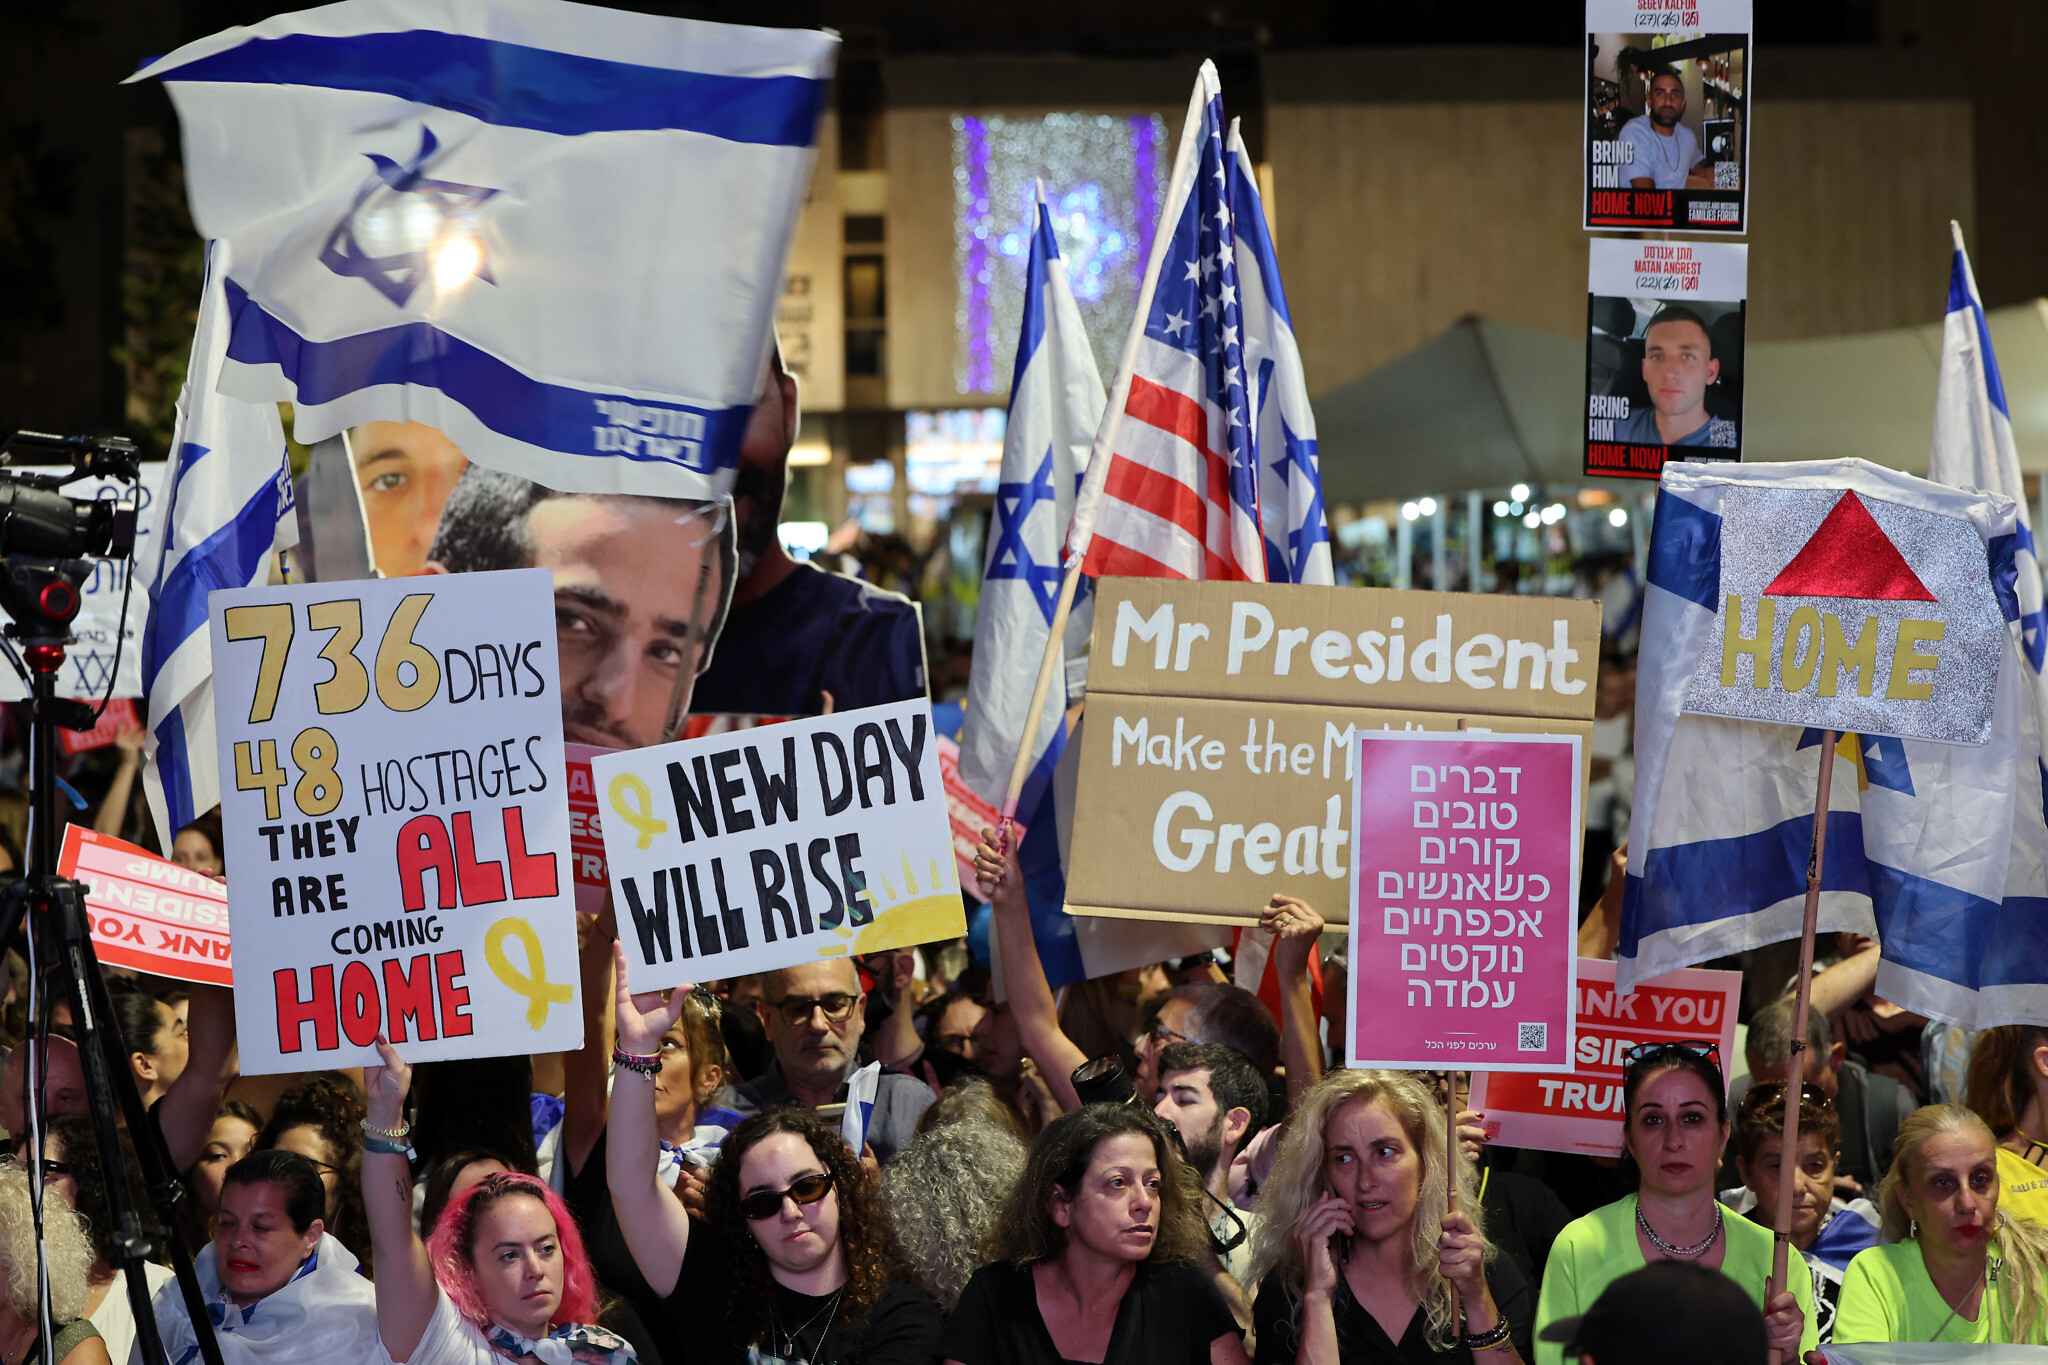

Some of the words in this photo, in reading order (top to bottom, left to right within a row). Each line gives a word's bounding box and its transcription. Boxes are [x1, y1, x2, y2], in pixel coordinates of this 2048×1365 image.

[1592, 140, 1634, 165] BRING
[1592, 165, 1619, 188] HIM
[1592, 191, 1631, 215] HOME
[1634, 190, 1673, 216] NOW!
[1689, 209, 1716, 221] FAMILIES
[1717, 210, 1739, 222] FORUM
[1634, 260, 1662, 273] MATAN
[1664, 261, 1702, 275] ANGREST
[1677, 247, 1692, 261] מתן
[1589, 395, 1630, 419] BRING
[1589, 419, 1615, 441] HIM
[1588, 444, 1627, 467] HOME
[224, 593, 441, 724] 736
[445, 641, 546, 704] DAYS
[1112, 600, 1210, 672] Mr
[1226, 601, 1587, 695] President
[1720, 594, 1946, 701] HOME
[1112, 716, 1226, 772] Make
[1240, 718, 1315, 775] the
[233, 727, 343, 820] 48
[361, 735, 547, 816] HOSTAGES
[666, 737, 798, 843] NEW
[810, 714, 926, 817] DAY
[1410, 765, 1522, 795] דברים
[1413, 800, 1518, 830] טובים
[258, 816, 360, 862] THEY
[1152, 790, 1349, 880] Great
[397, 805, 560, 913] ALL
[1419, 836, 1520, 873] קורים
[272, 873, 348, 918] ARE
[621, 857, 750, 966] WILL
[749, 832, 875, 943] RISE
[1378, 871, 1551, 902] כשאנשים
[331, 916, 444, 955] COMING
[1383, 907, 1543, 938] אכפתיים
[1401, 943, 1524, 979] נוקטים
[273, 950, 473, 1054] HOME
[1407, 978, 1516, 1009] עמדה
[1650, 994, 1720, 1026] YOU
[1425, 1039, 1444, 1049] הכל
[1446, 1040, 1466, 1050] לפני
[1468, 1041, 1497, 1050] ערכים
